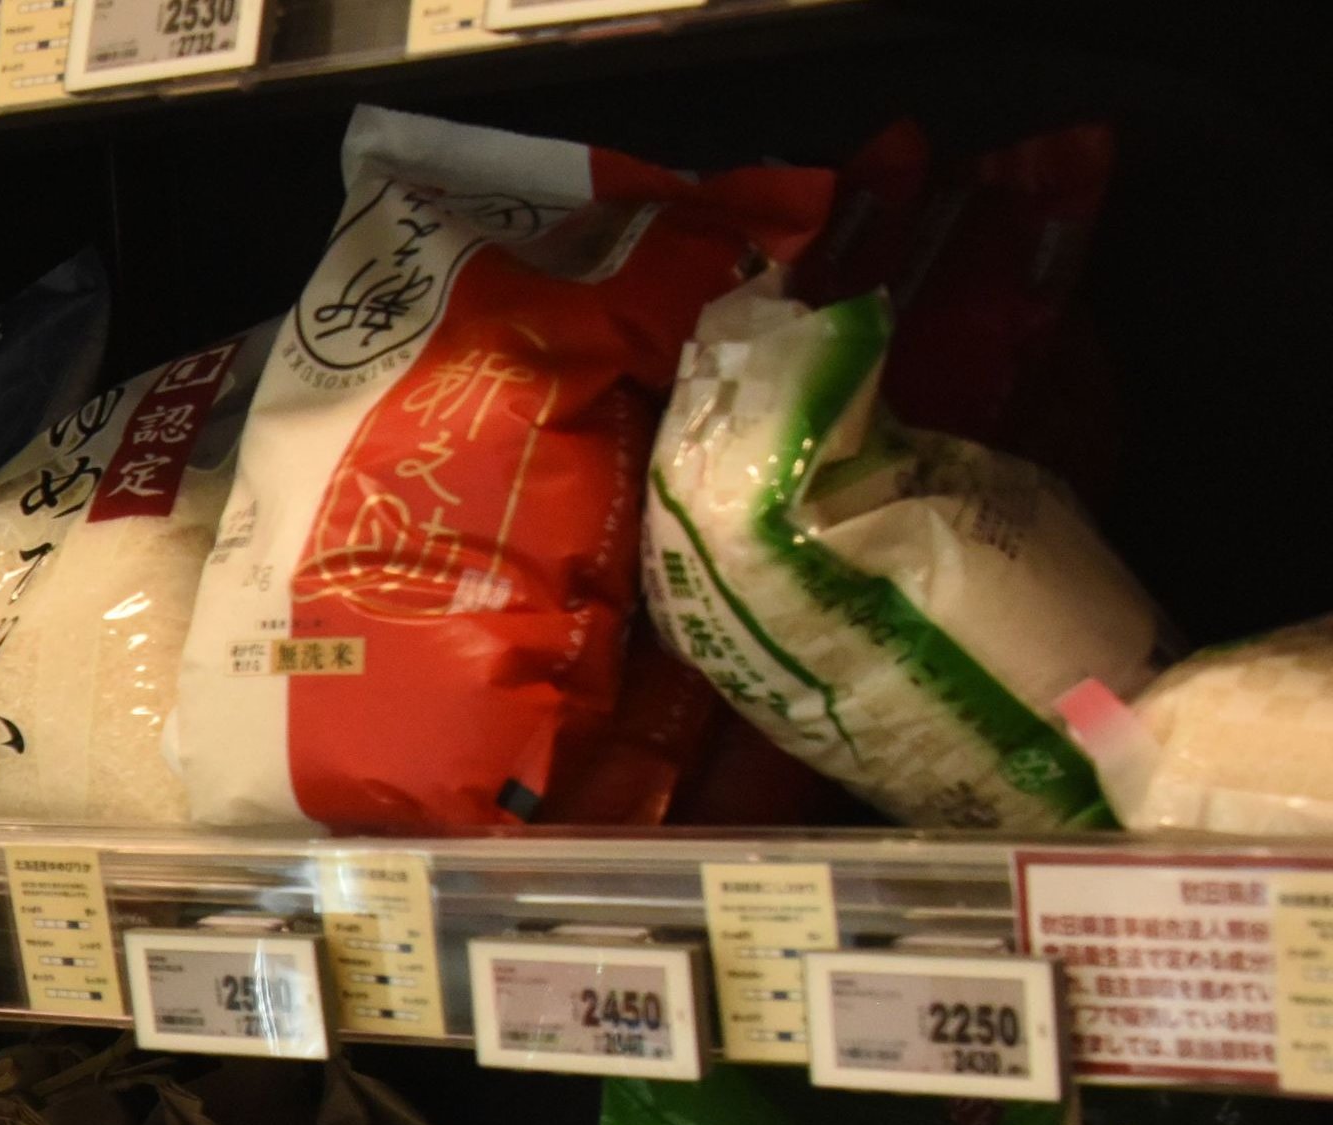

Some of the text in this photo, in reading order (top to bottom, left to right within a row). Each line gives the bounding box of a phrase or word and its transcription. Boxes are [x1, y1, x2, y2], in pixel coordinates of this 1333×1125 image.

[110, 403, 194, 501] 認定
[580, 989, 661, 1030] 2450
[929, 1001, 1020, 1046] 2250
